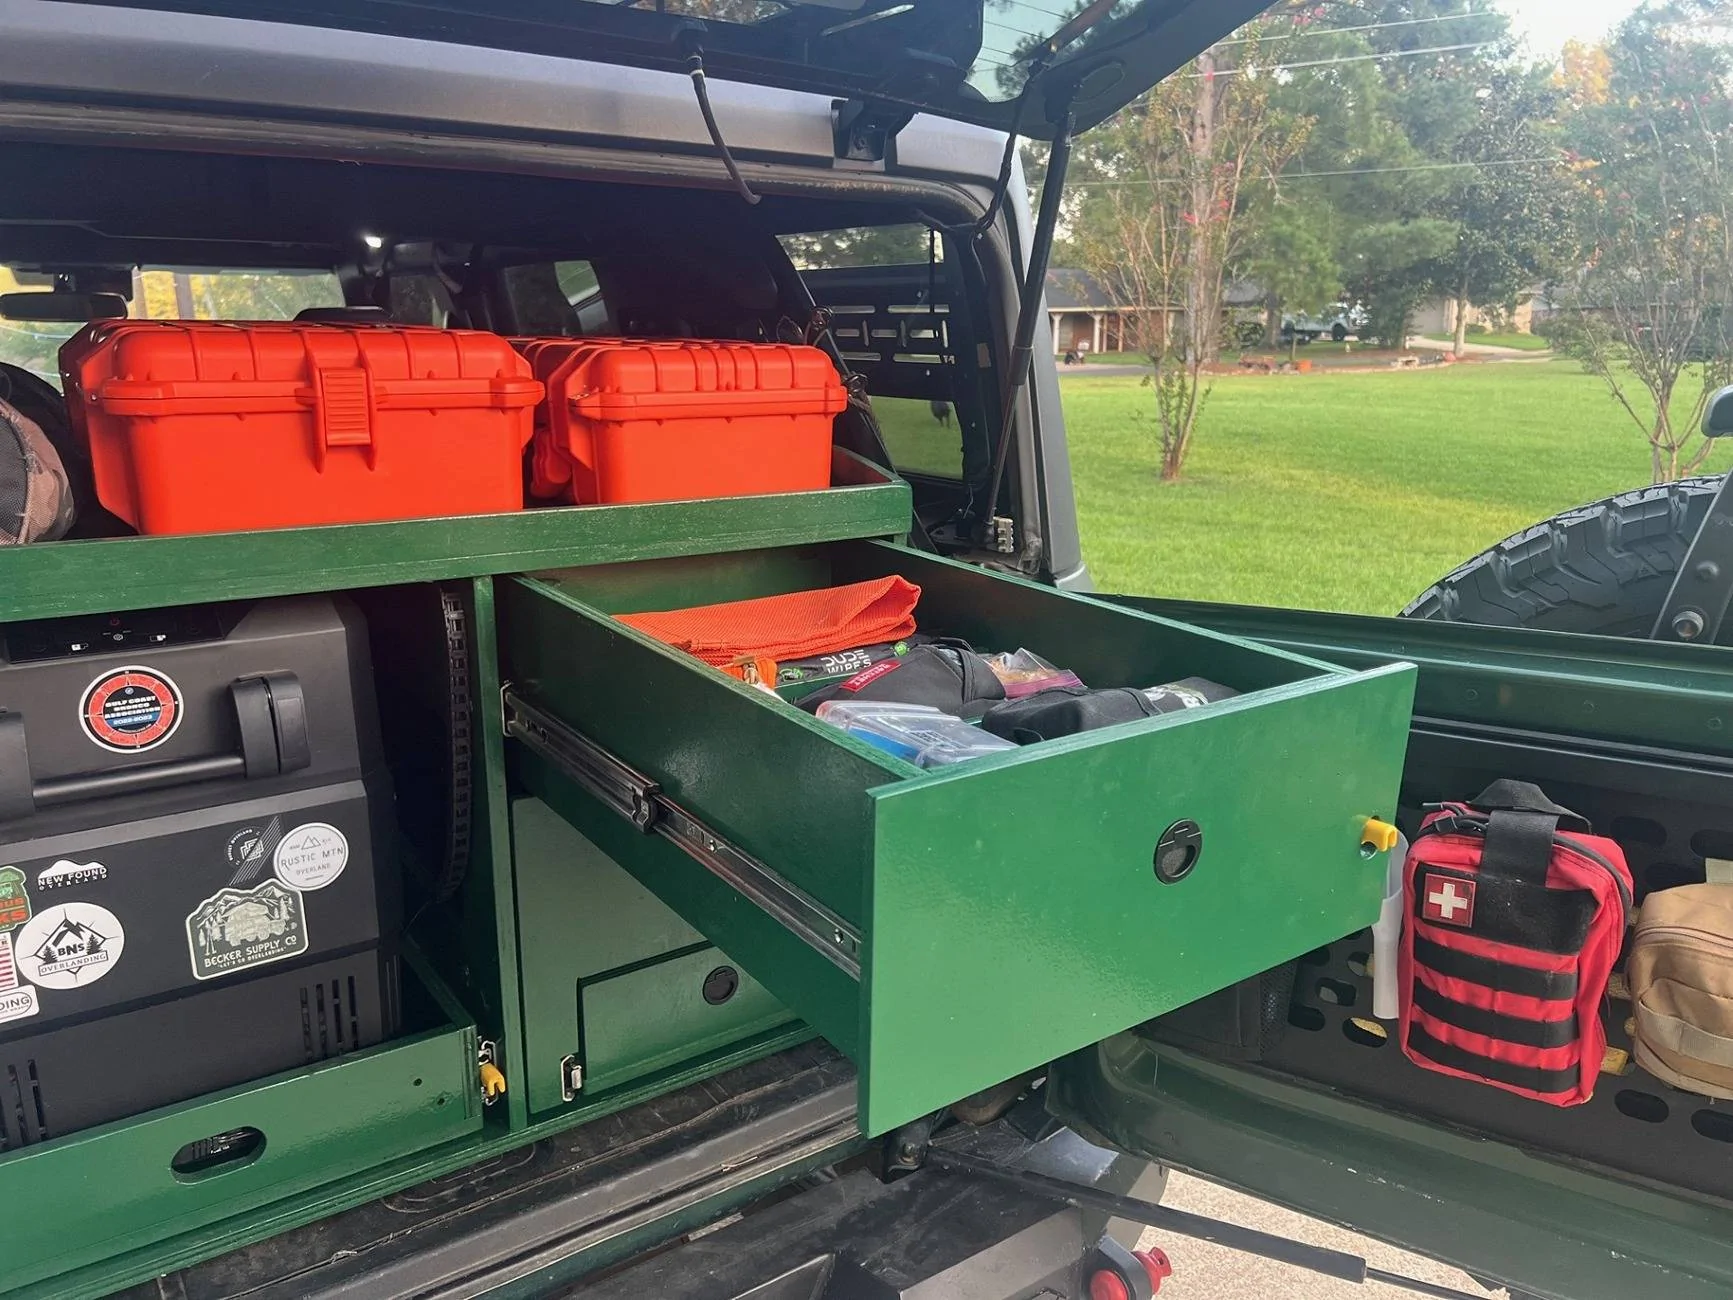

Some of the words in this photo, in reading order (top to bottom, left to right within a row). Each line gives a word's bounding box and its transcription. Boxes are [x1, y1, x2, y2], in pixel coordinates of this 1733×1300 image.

[820, 649, 869, 667] DUDE
[105, 700, 127, 708] GULF
[128, 696, 156, 704] COAST
[113, 702, 150, 711] BRONCO
[104, 706, 160, 718] ASSOCIATION
[281, 853, 316, 871] RUSTIC
[322, 847, 344, 858] MTN
[38, 875, 64, 886] NEW
[68, 867, 107, 880] FOUND
[39, 874, 107, 890] OVERLAND
[204, 950, 241, 967] BECKER
[246, 940, 280, 955] SUPPLY
[41, 953, 107, 973] OVERLANDING
